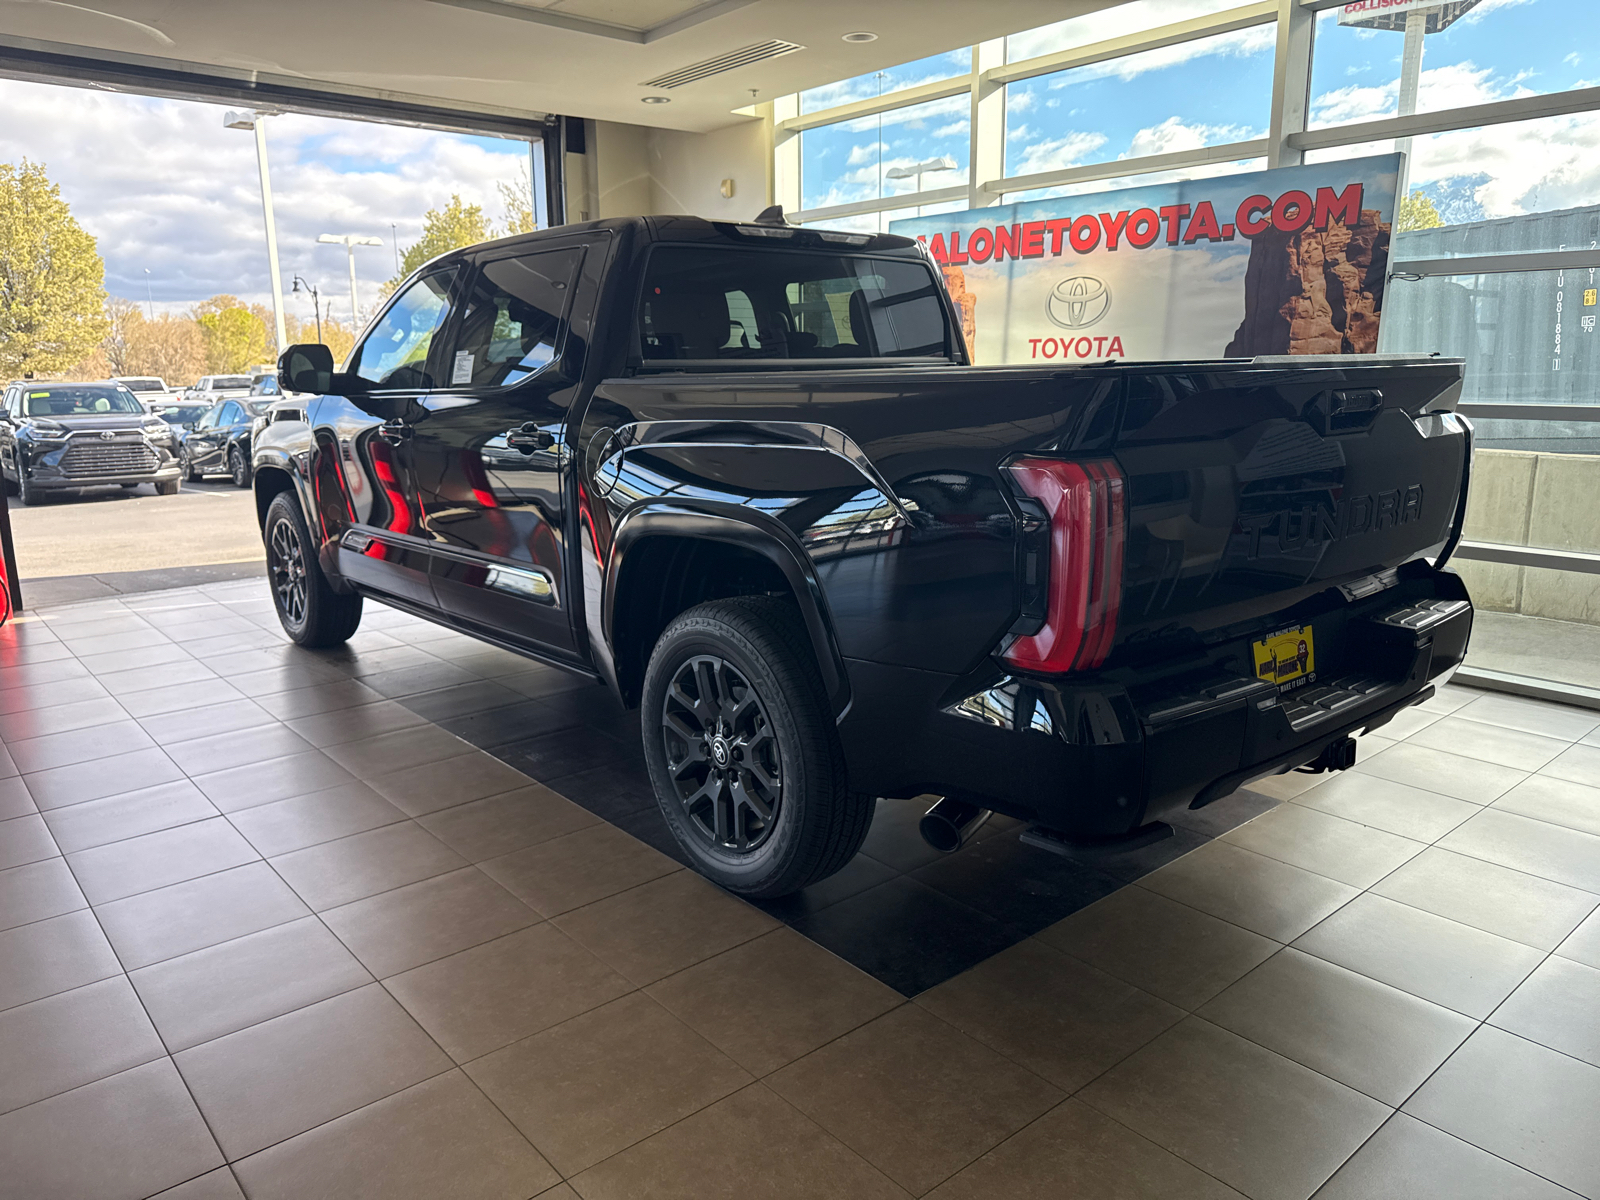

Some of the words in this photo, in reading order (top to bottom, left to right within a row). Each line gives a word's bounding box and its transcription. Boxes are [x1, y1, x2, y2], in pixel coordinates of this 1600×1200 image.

[916, 183, 1364, 266] ALONETOYOTA.COM
[1029, 336, 1125, 359] TOYOTA
[1237, 483, 1424, 561] TUNDRA
[1299, 644, 1306, 653] 32
[1280, 682, 1292, 693] MAKE
[1291, 680, 1296, 689] IT
[1296, 677, 1306, 687] EASY
